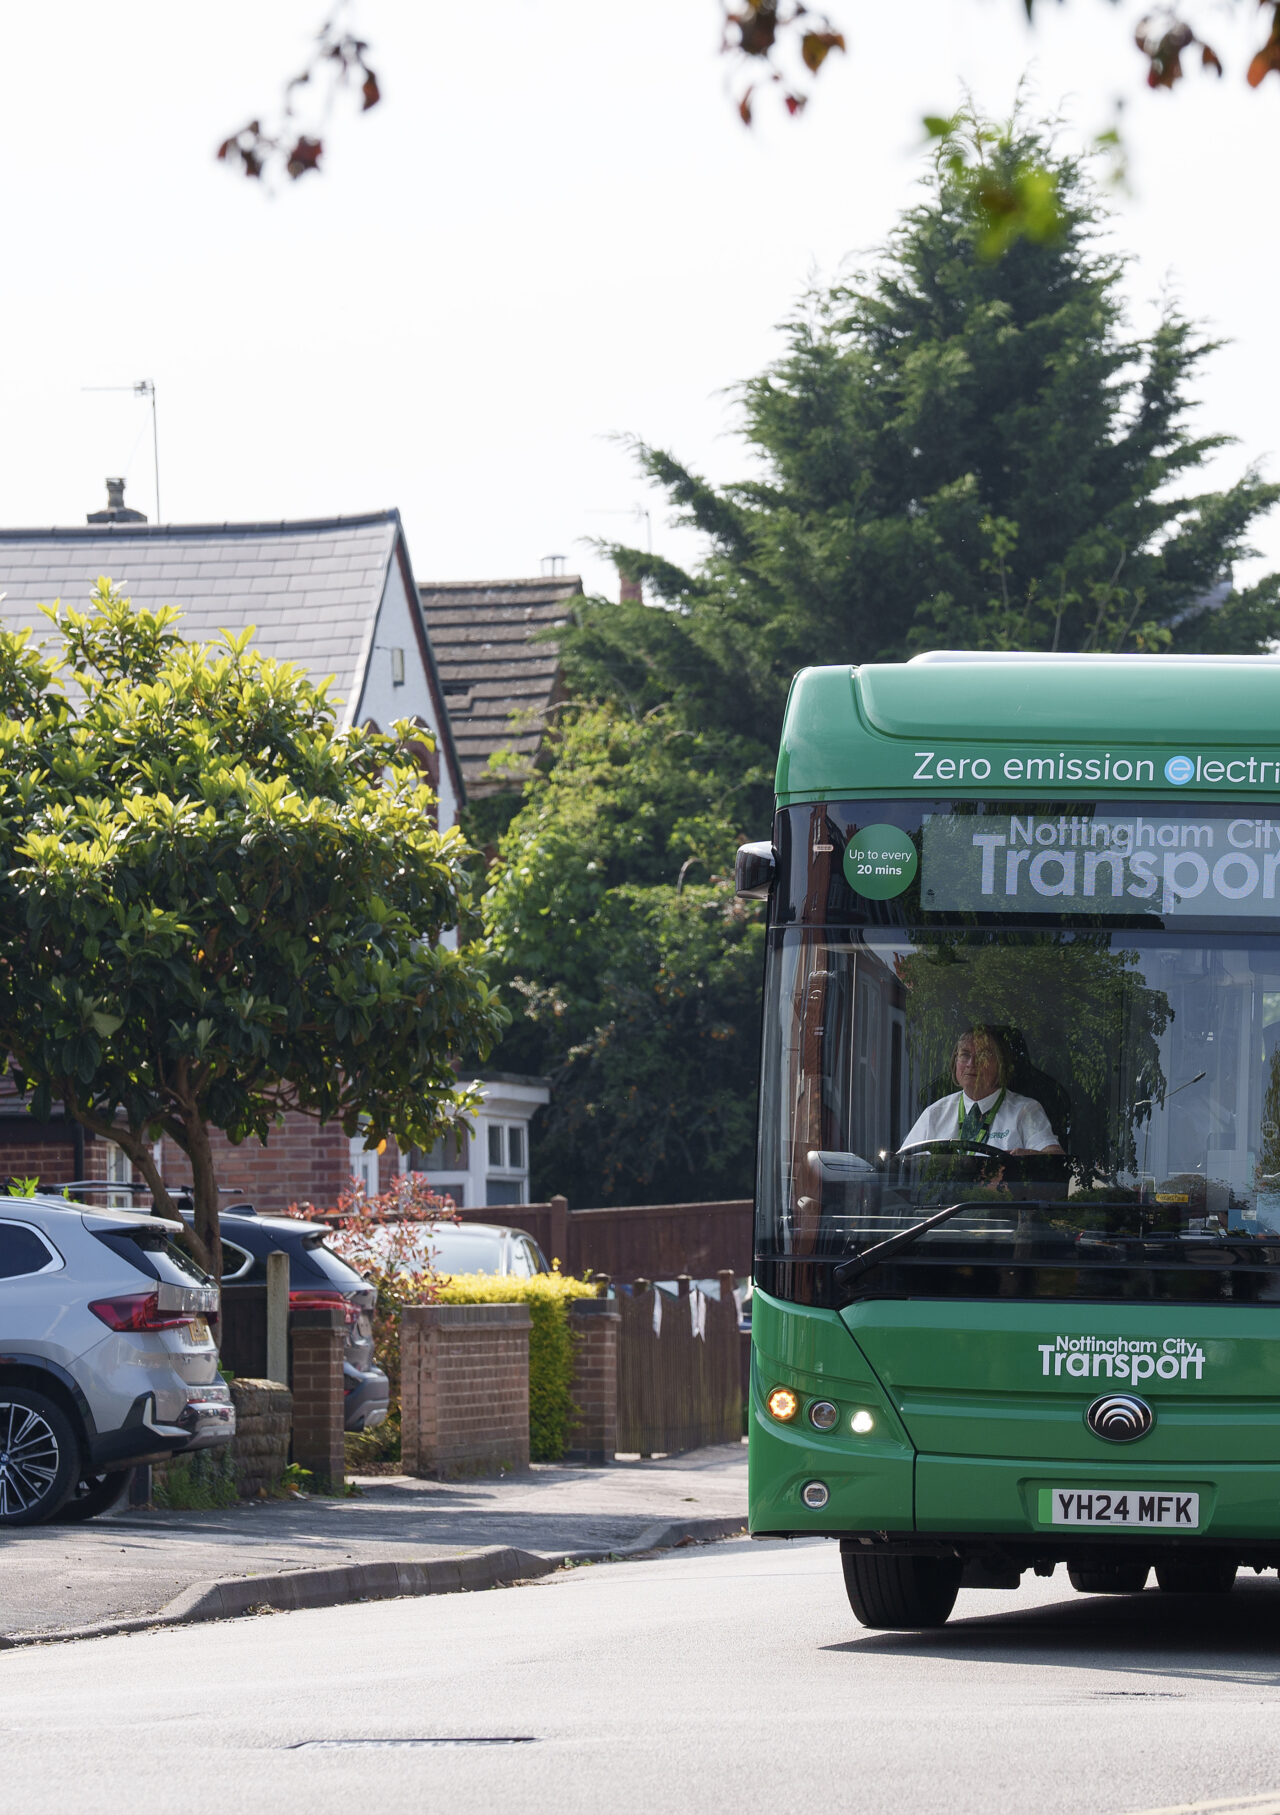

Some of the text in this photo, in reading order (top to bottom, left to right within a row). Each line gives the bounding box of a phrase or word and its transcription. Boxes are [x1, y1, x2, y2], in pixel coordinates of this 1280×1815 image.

[912, 752, 992, 780] Zero
[1003, 752, 1155, 781] emission
[1010, 816, 1214, 858] Nottingham
[849, 849, 912, 862] Up to every
[857, 864, 902, 875] 20 mins
[1056, 1335, 1198, 1358] Nottingham City
[1038, 1344, 1206, 1386] Transport
[1058, 1494, 1192, 1523] YH24 MFK
